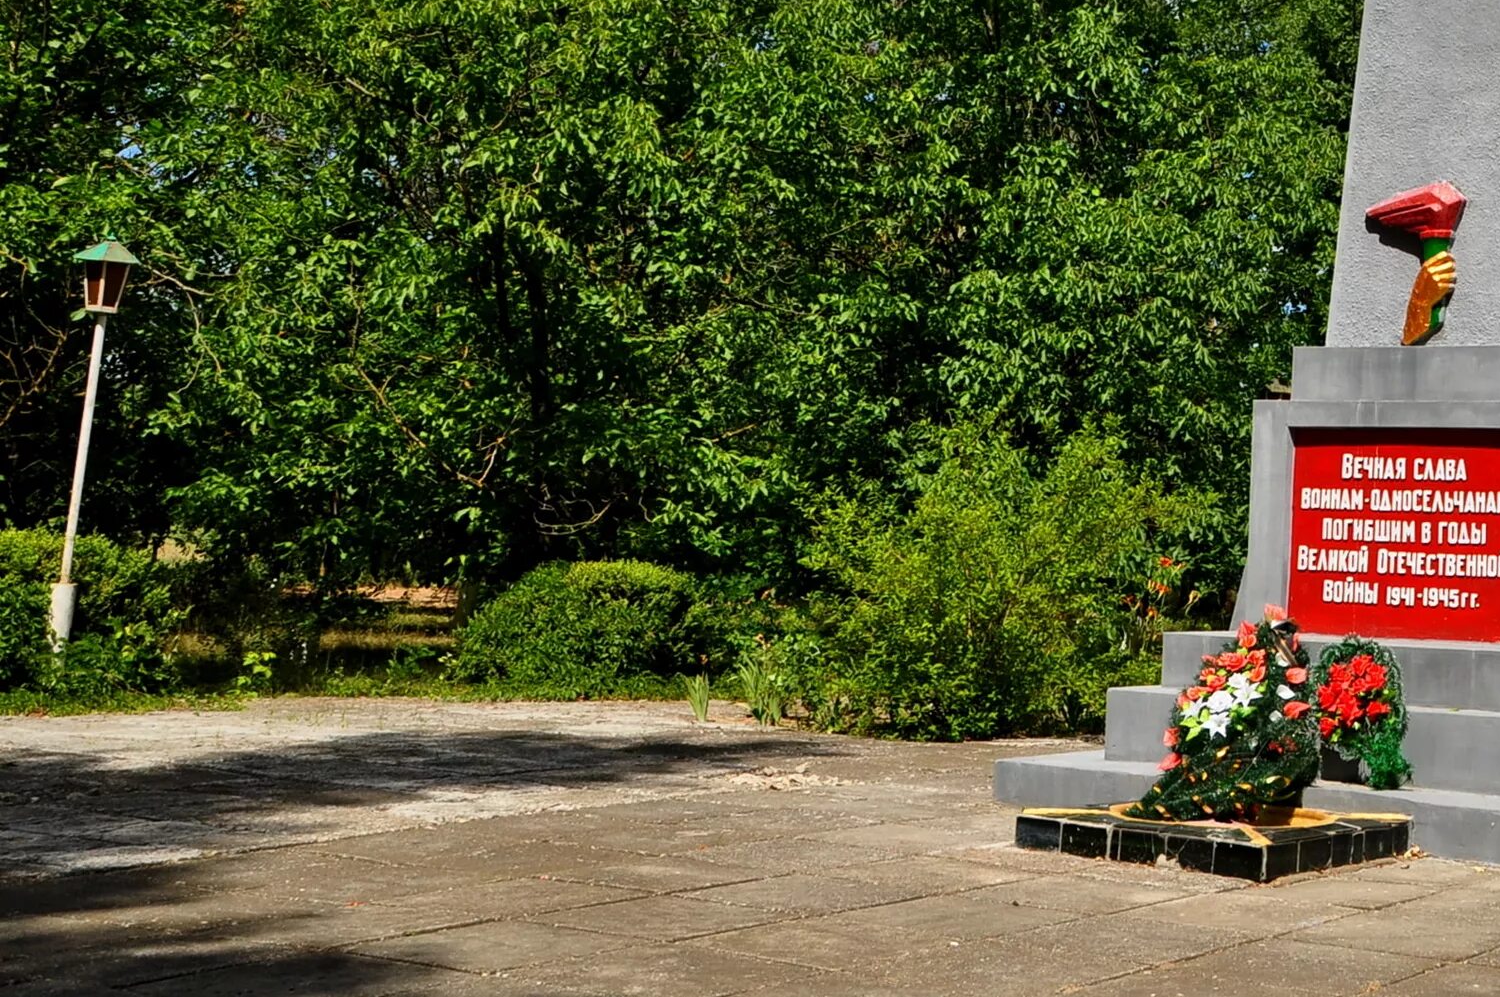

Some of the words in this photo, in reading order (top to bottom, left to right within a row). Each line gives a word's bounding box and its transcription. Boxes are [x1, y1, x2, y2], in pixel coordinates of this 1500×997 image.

[1341, 453, 1407, 480] ВЕЧНАЯ
[1413, 457, 1467, 481] СЛАВА
[1322, 518, 1416, 543] ПОГИБШИМ
[1421, 521, 1431, 544] В
[1437, 522, 1487, 545] ГОДЫ
[1297, 545, 1369, 573] ВЕЛИКОЙ
[1322, 577, 1379, 605] ВОЙНЫ
